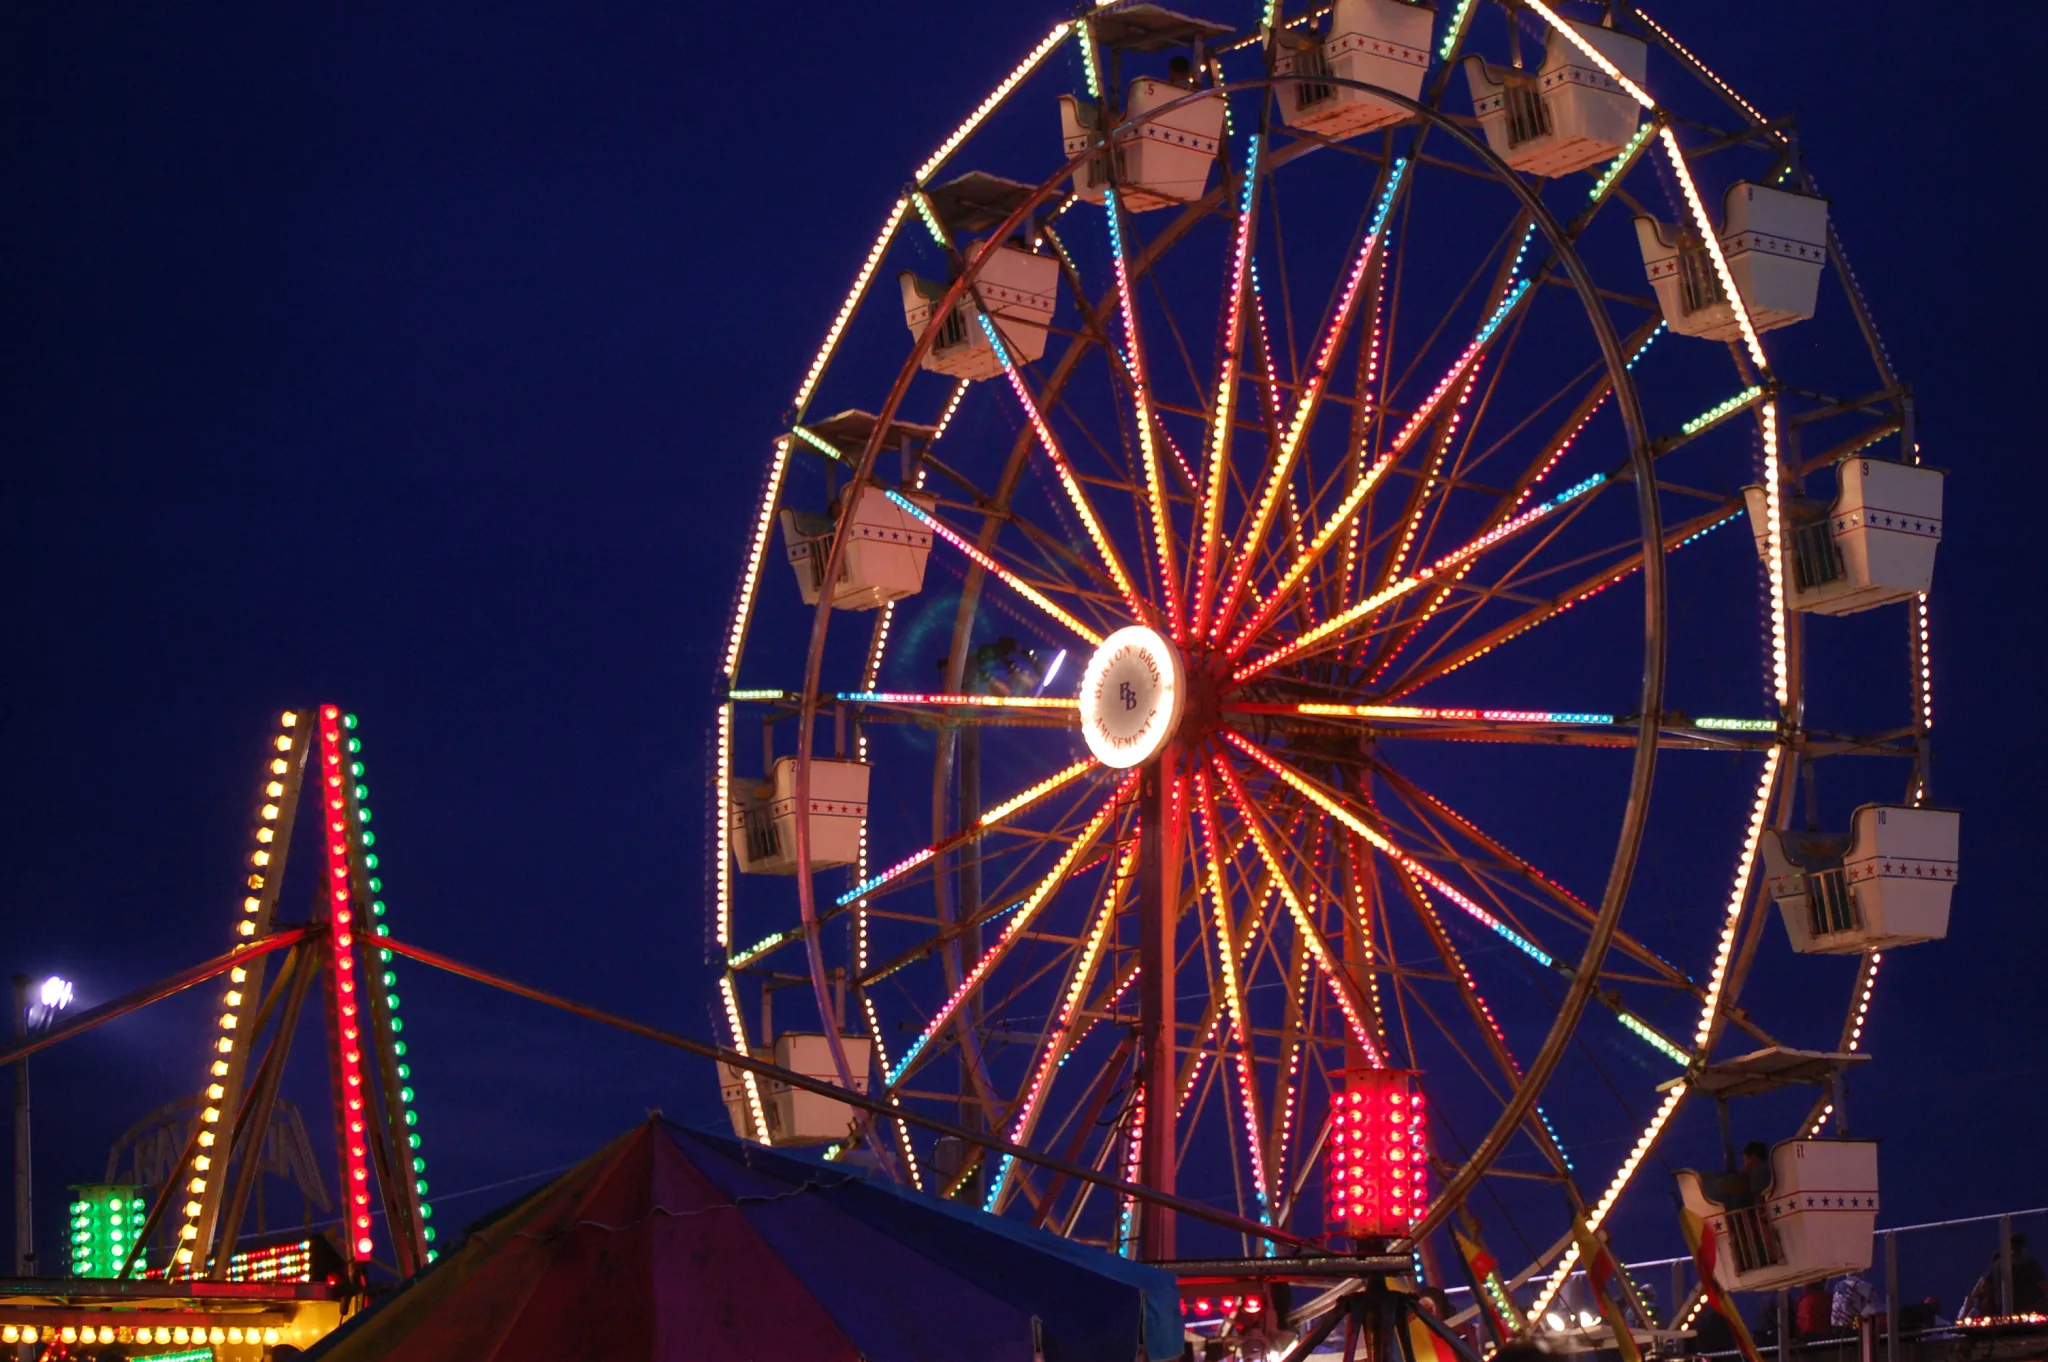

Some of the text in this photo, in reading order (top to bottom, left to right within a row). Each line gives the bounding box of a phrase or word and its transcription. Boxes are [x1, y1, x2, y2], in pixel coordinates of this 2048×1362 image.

[1862, 461, 1870, 476] 9
[1139, 647, 1161, 688] BROS.
[1095, 708, 1157, 750] AMUSEMENTS
[790, 760, 797, 773] 2
[1877, 810, 1887, 825] 10
